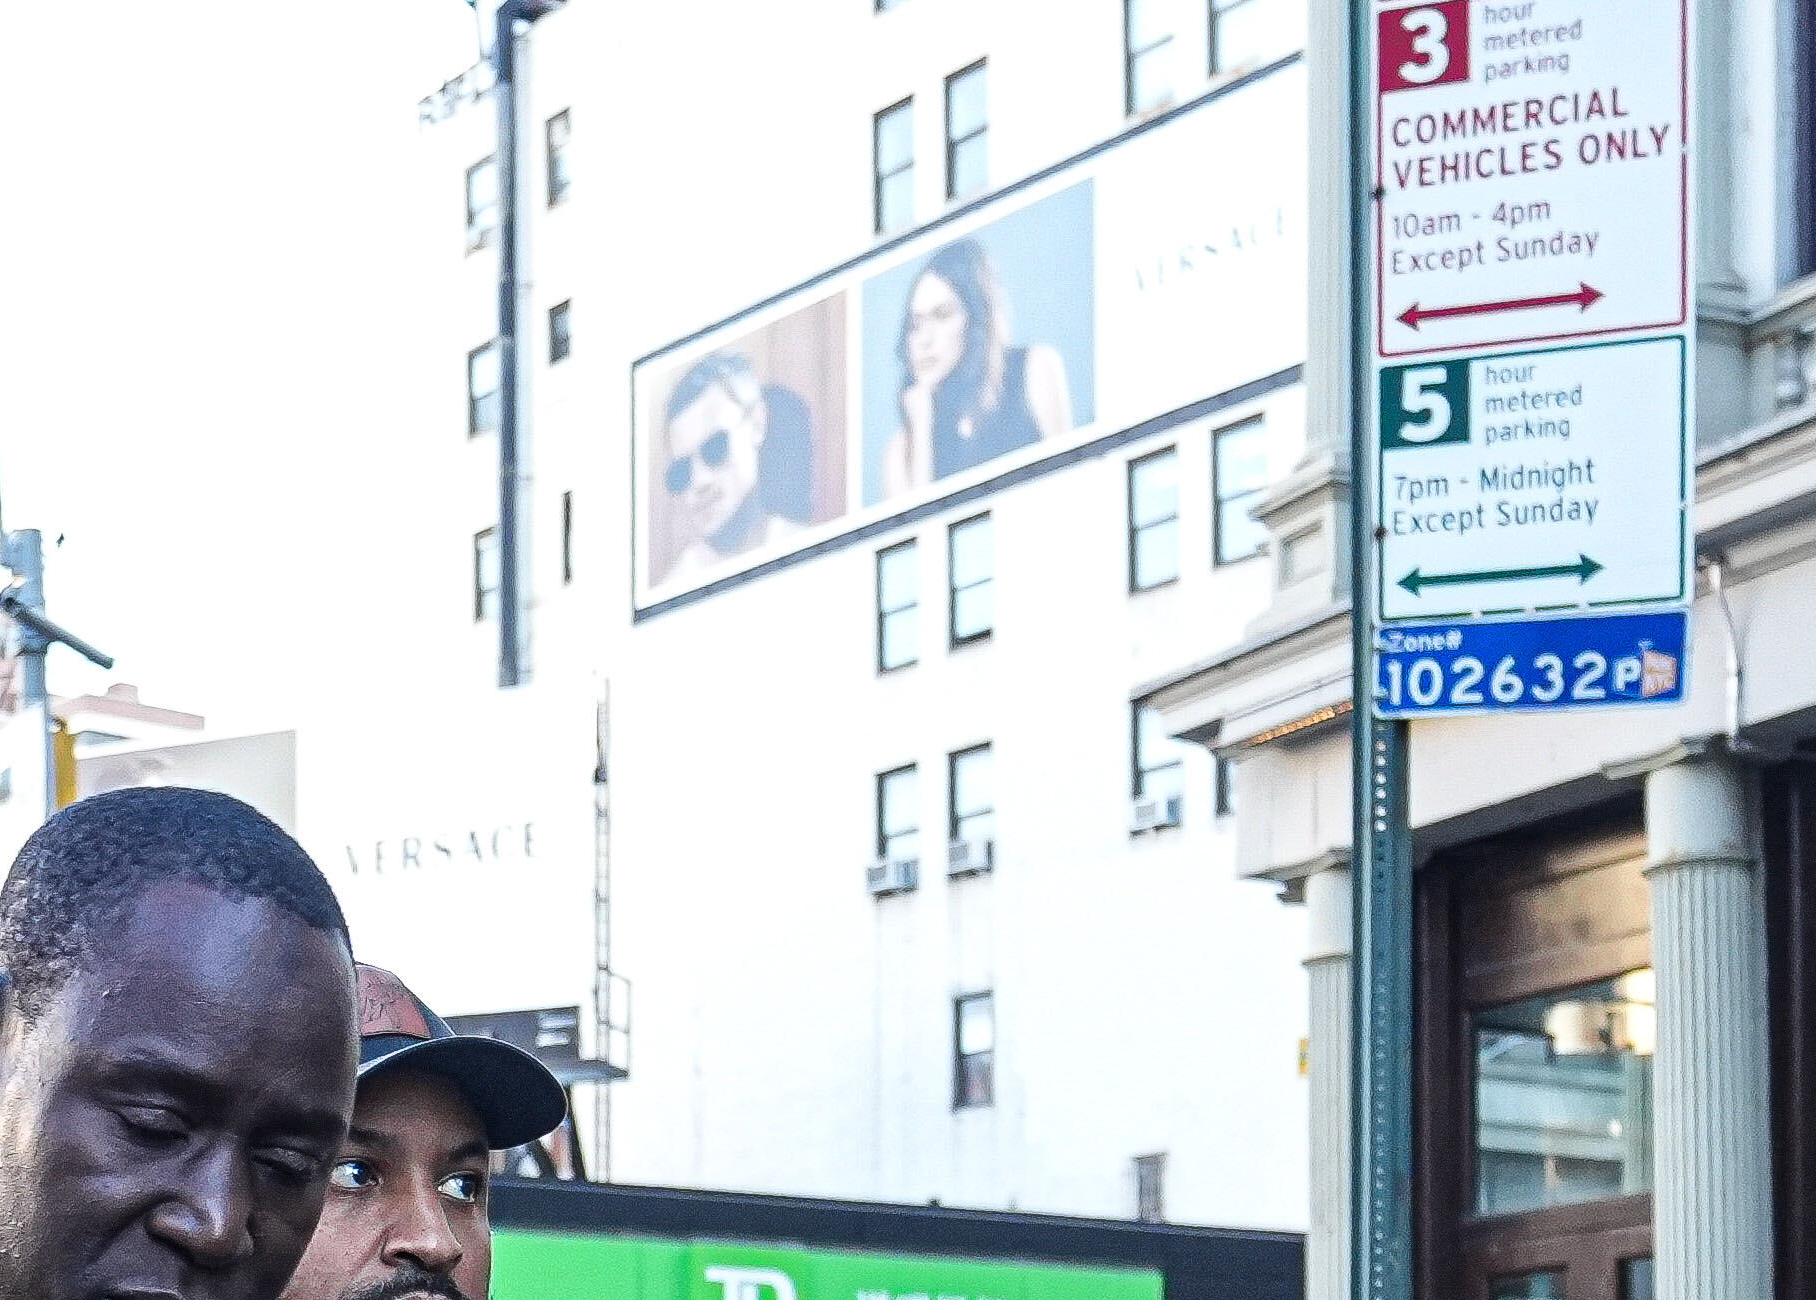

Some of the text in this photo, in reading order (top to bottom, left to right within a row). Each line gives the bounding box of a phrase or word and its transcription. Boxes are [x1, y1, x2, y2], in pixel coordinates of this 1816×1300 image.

[1484, 2, 1535, 25] hour
[1397, 6, 1449, 84] 3
[1484, 18, 1583, 51] metered
[1484, 51, 1570, 83] parking
[1392, 86, 1629, 148] COMMERCIAL
[1393, 122, 1671, 190] VEHICLES ONLY
[1393, 211, 1462, 240] 10am
[1491, 199, 1553, 229] 4pm
[1391, 230, 1600, 276] Except Sunday
[1484, 364, 1537, 386] hour
[1398, 364, 1452, 443] 5
[1484, 382, 1583, 414] metered
[1485, 416, 1571, 446] parking
[1394, 474, 1449, 503] 7pm
[1479, 456, 1595, 494] Midnight
[1392, 497, 1600, 537] Except Sunday
[1387, 649, 1608, 706] 102632
